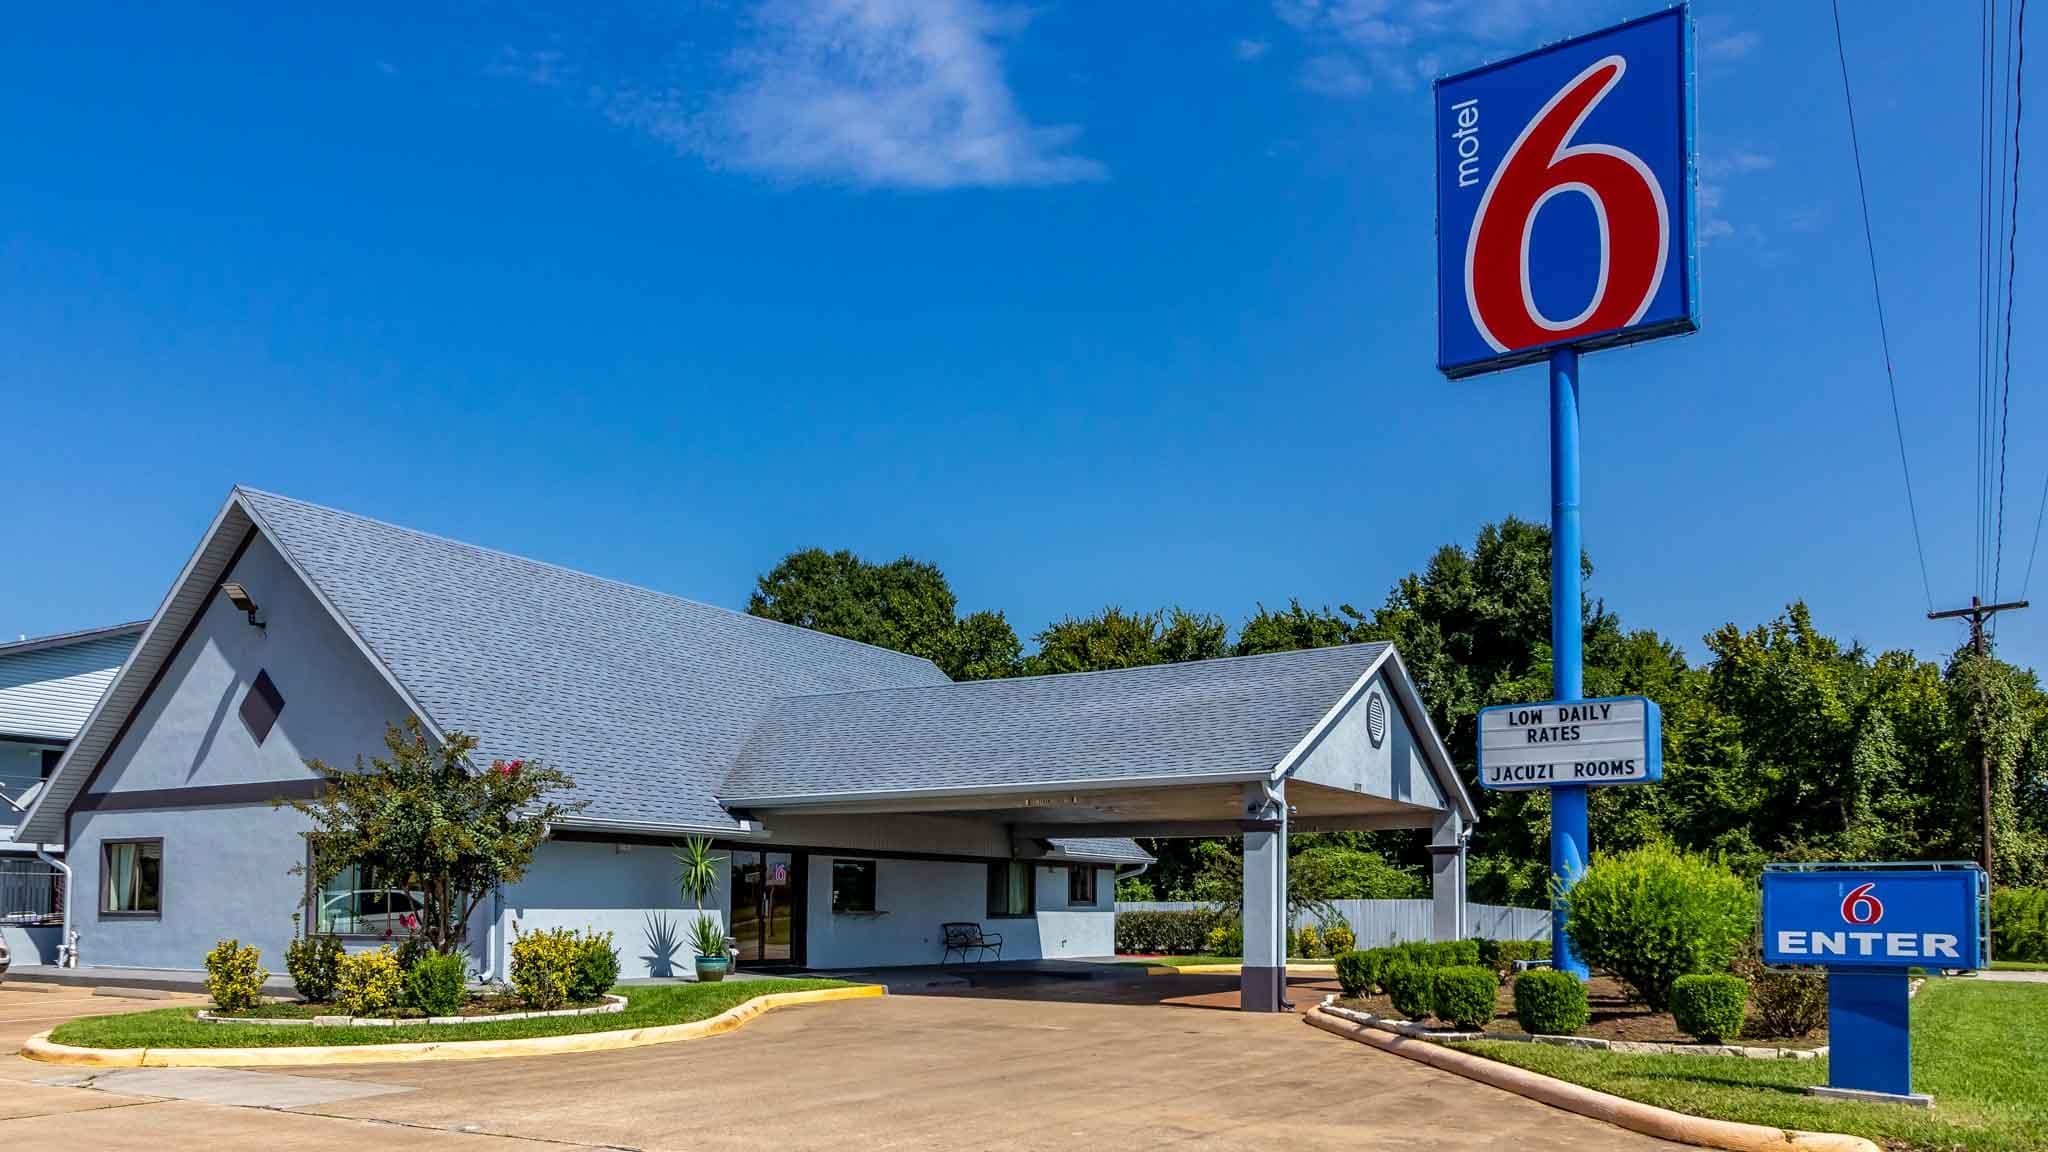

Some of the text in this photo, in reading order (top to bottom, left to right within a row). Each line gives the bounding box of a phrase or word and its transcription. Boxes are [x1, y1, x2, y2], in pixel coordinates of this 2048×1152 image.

[1452, 55, 1670, 353] motel 6
[1509, 704, 1611, 726] LOW DAILY
[1527, 725, 1580, 743] RATES
[1491, 760, 1635, 781] JACUZI ROOMS
[1840, 882, 1884, 925] 6
[1778, 931, 1960, 957] ENTER
